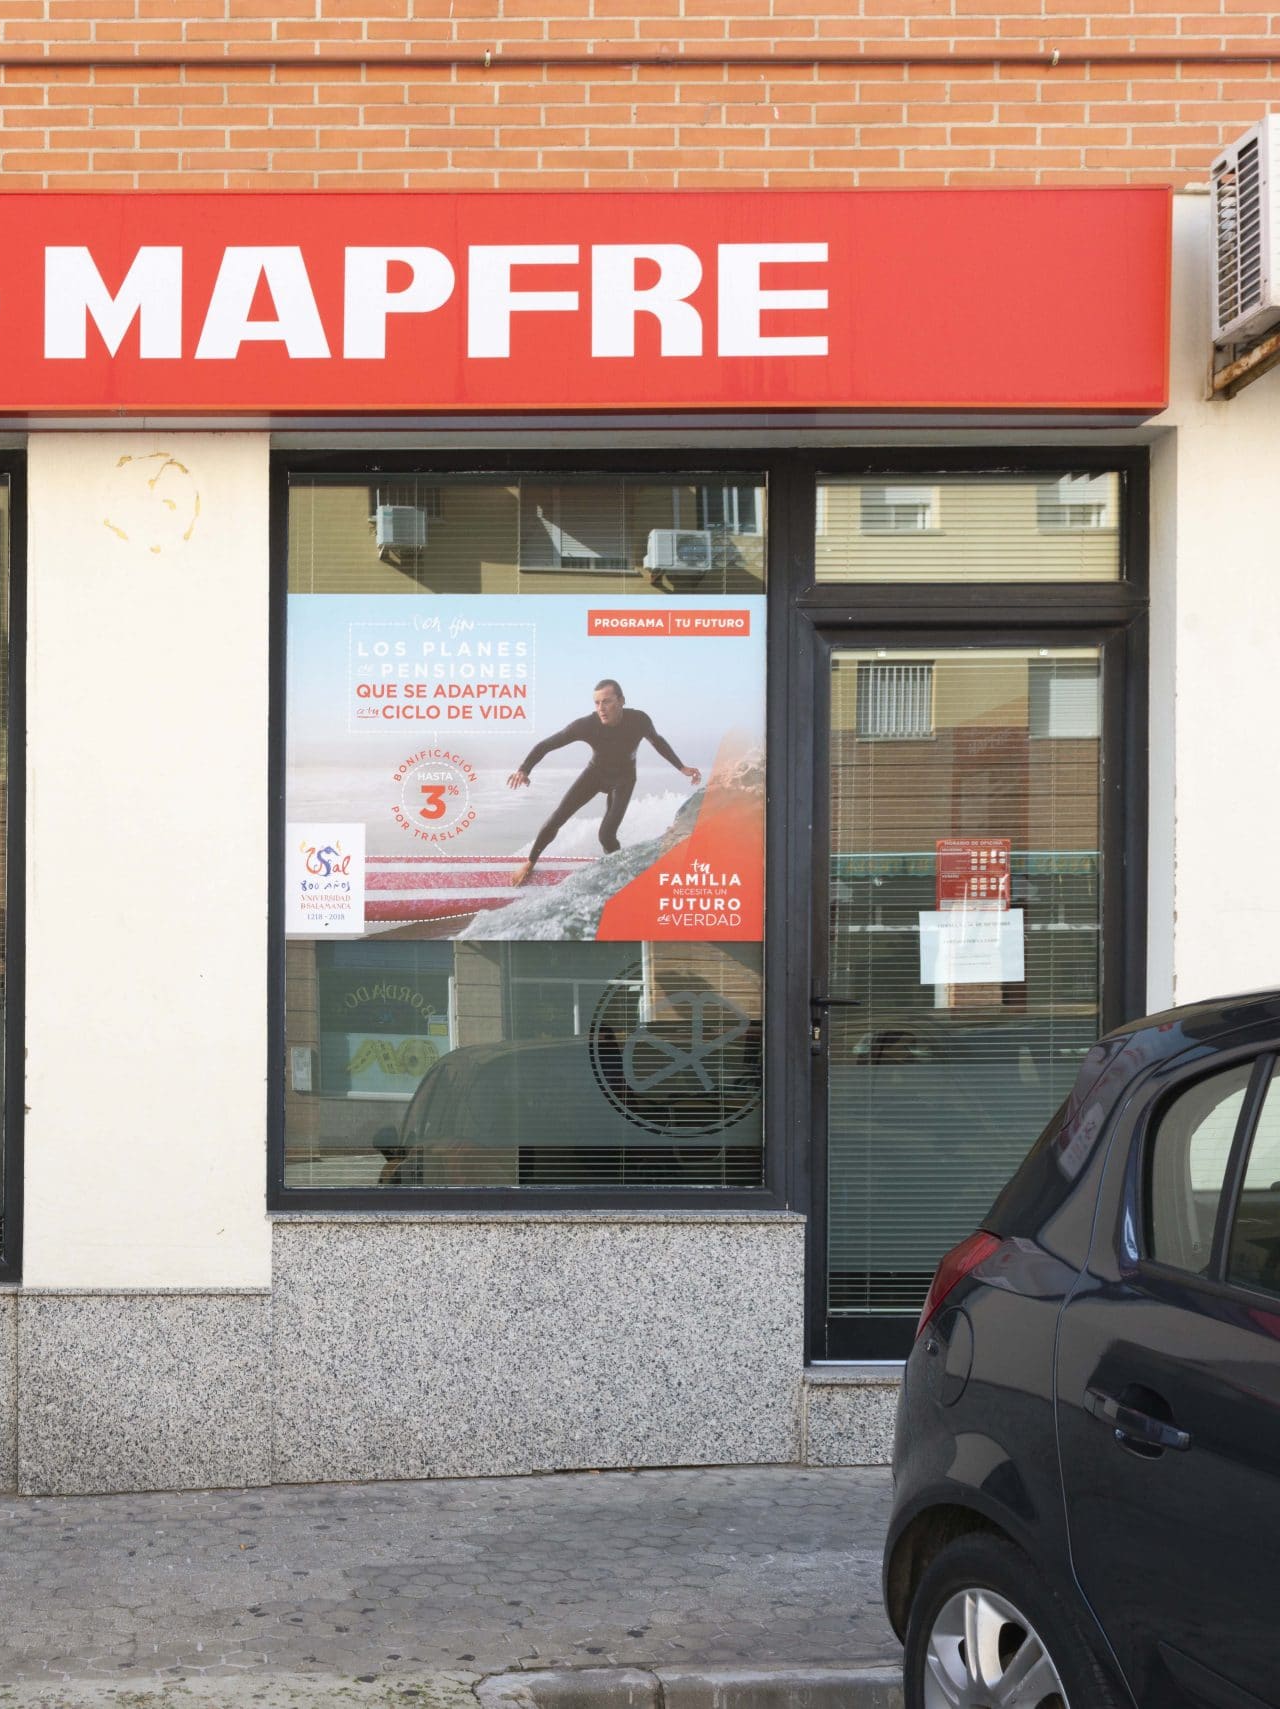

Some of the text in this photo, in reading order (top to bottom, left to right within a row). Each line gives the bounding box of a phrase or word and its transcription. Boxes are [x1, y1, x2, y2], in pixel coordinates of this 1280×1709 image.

[44, 241, 830, 361] MAPFRE
[594, 618, 745, 628] PROGRAMA TU FUTURO
[358, 641, 528, 657] LOS PLANES
[381, 663, 528, 678] PENSIONES
[356, 683, 527, 699] QUE SE ADAPTAN
[382, 704, 440, 720] CICLO
[447, 704, 473, 720] DE
[479, 704, 527, 720] VIDA
[417, 772, 453, 781] HASTA
[391, 805, 410, 830] POR
[691, 858, 711, 874] tu
[300, 880, 319, 892] 800
[659, 873, 742, 886] FAMILIA
[659, 897, 741, 911] FUTURO
[307, 913, 322, 921] 1218
[329, 913, 345, 921] 2018
[657, 913, 742, 926] de VERDAD
